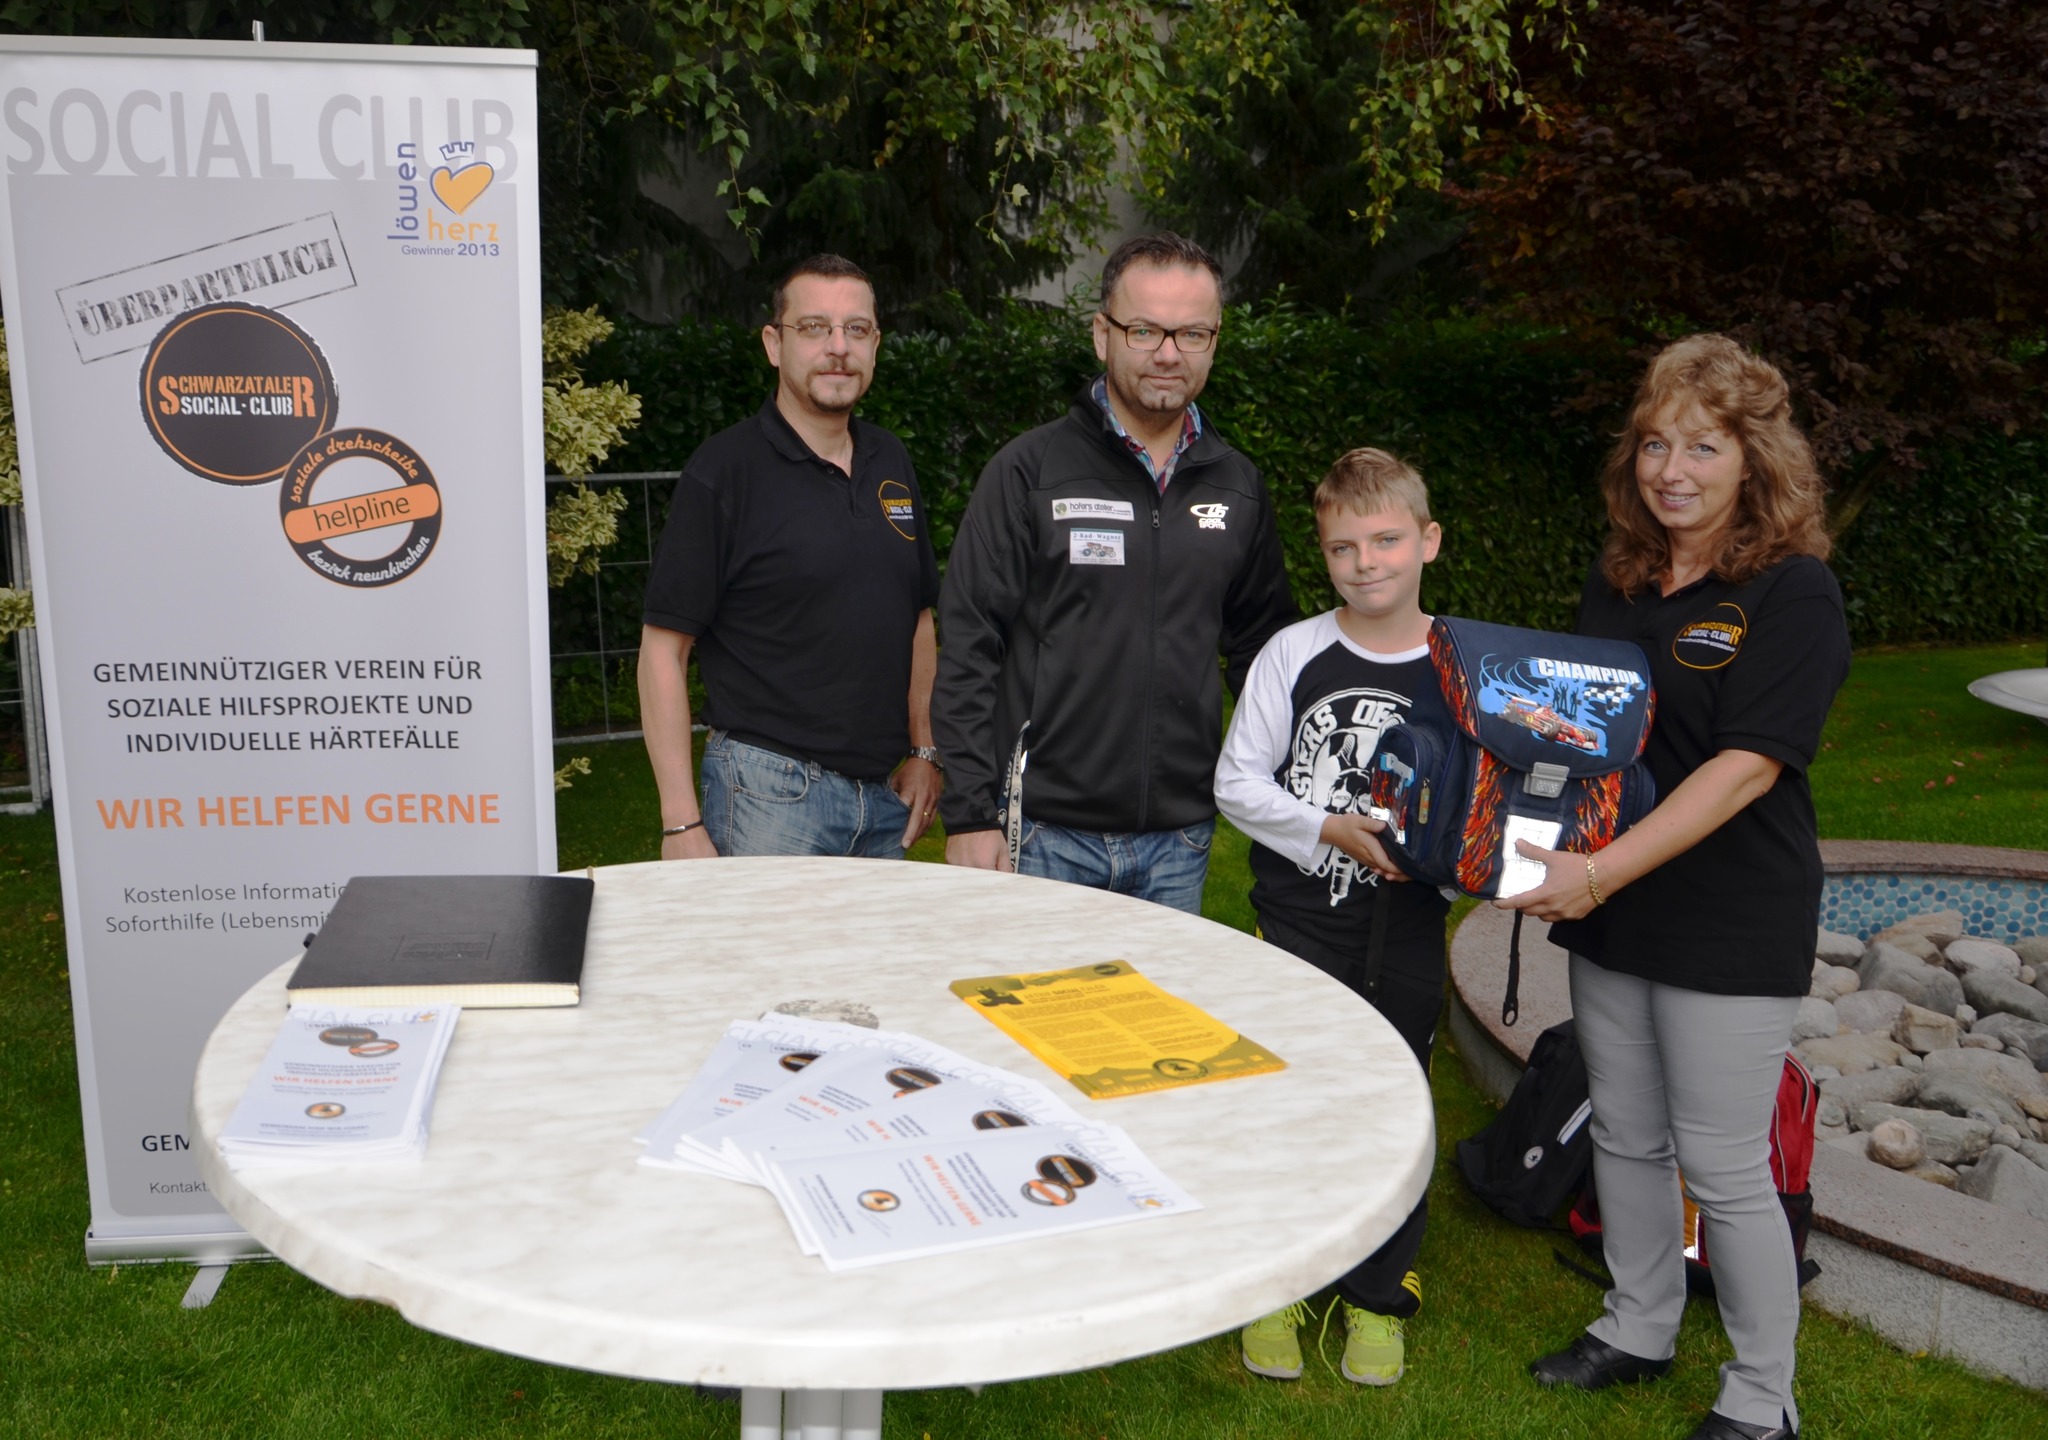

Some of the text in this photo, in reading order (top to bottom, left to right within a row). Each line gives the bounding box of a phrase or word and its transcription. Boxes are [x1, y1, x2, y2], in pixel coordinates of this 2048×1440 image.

[3, 87, 519, 182] SOCIAL CLUB
[387, 143, 419, 240] löwen
[428, 208, 499, 241] herz
[401, 243, 500, 256] Gewinner 2013
[76, 239, 338, 336] ÜBERPARTEILICH
[158, 375, 316, 418] SCHWARZATALER
[290, 433, 419, 503] soziale drehscheibe
[313, 496, 411, 531] helpline
[307, 535, 430, 582] bezirk neunkirchen
[93, 656, 482, 683] GEMEINNÜTZIGER VEREIN FÜR
[1537, 657, 1640, 684] CHAMPION
[107, 695, 473, 719] SOZIALE HILFSPROJEKTE UND
[127, 726, 460, 753] INDIVIDUELLE HÄRTEFÄLLE
[1289, 699, 1397, 803] STERS OF
[96, 793, 500, 830] WIR HELFEN GERNE
[1010, 819, 1019, 853] TOM
[124, 882, 348, 904] Kostenlose Informatio
[106, 911, 331, 933] Soforthilfe (Lebensmi
